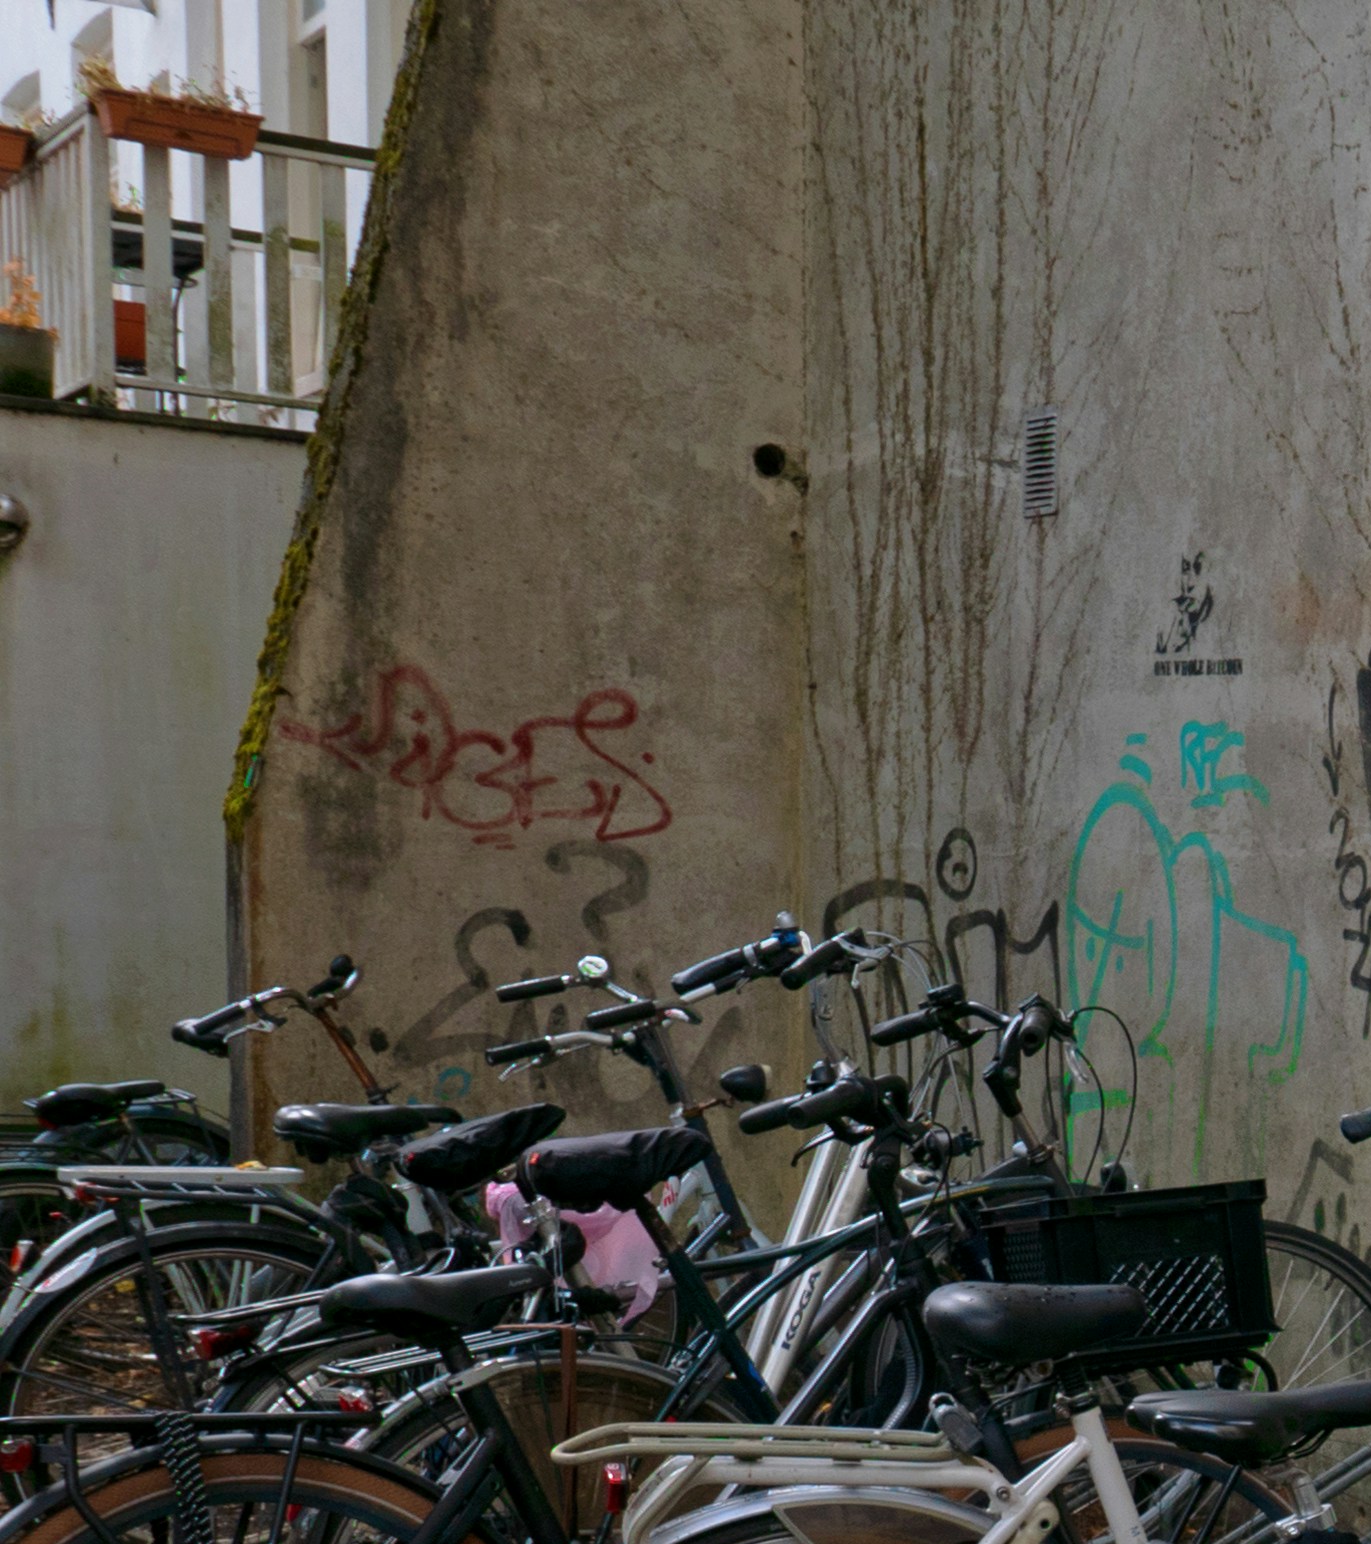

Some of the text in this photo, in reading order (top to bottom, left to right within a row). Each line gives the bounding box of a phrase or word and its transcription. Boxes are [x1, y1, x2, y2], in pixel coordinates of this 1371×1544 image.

[1154, 660, 1171, 676] ONE
[1173, 659, 1204, 677] WHOLE
[781, 1269, 822, 1350] KOGA
